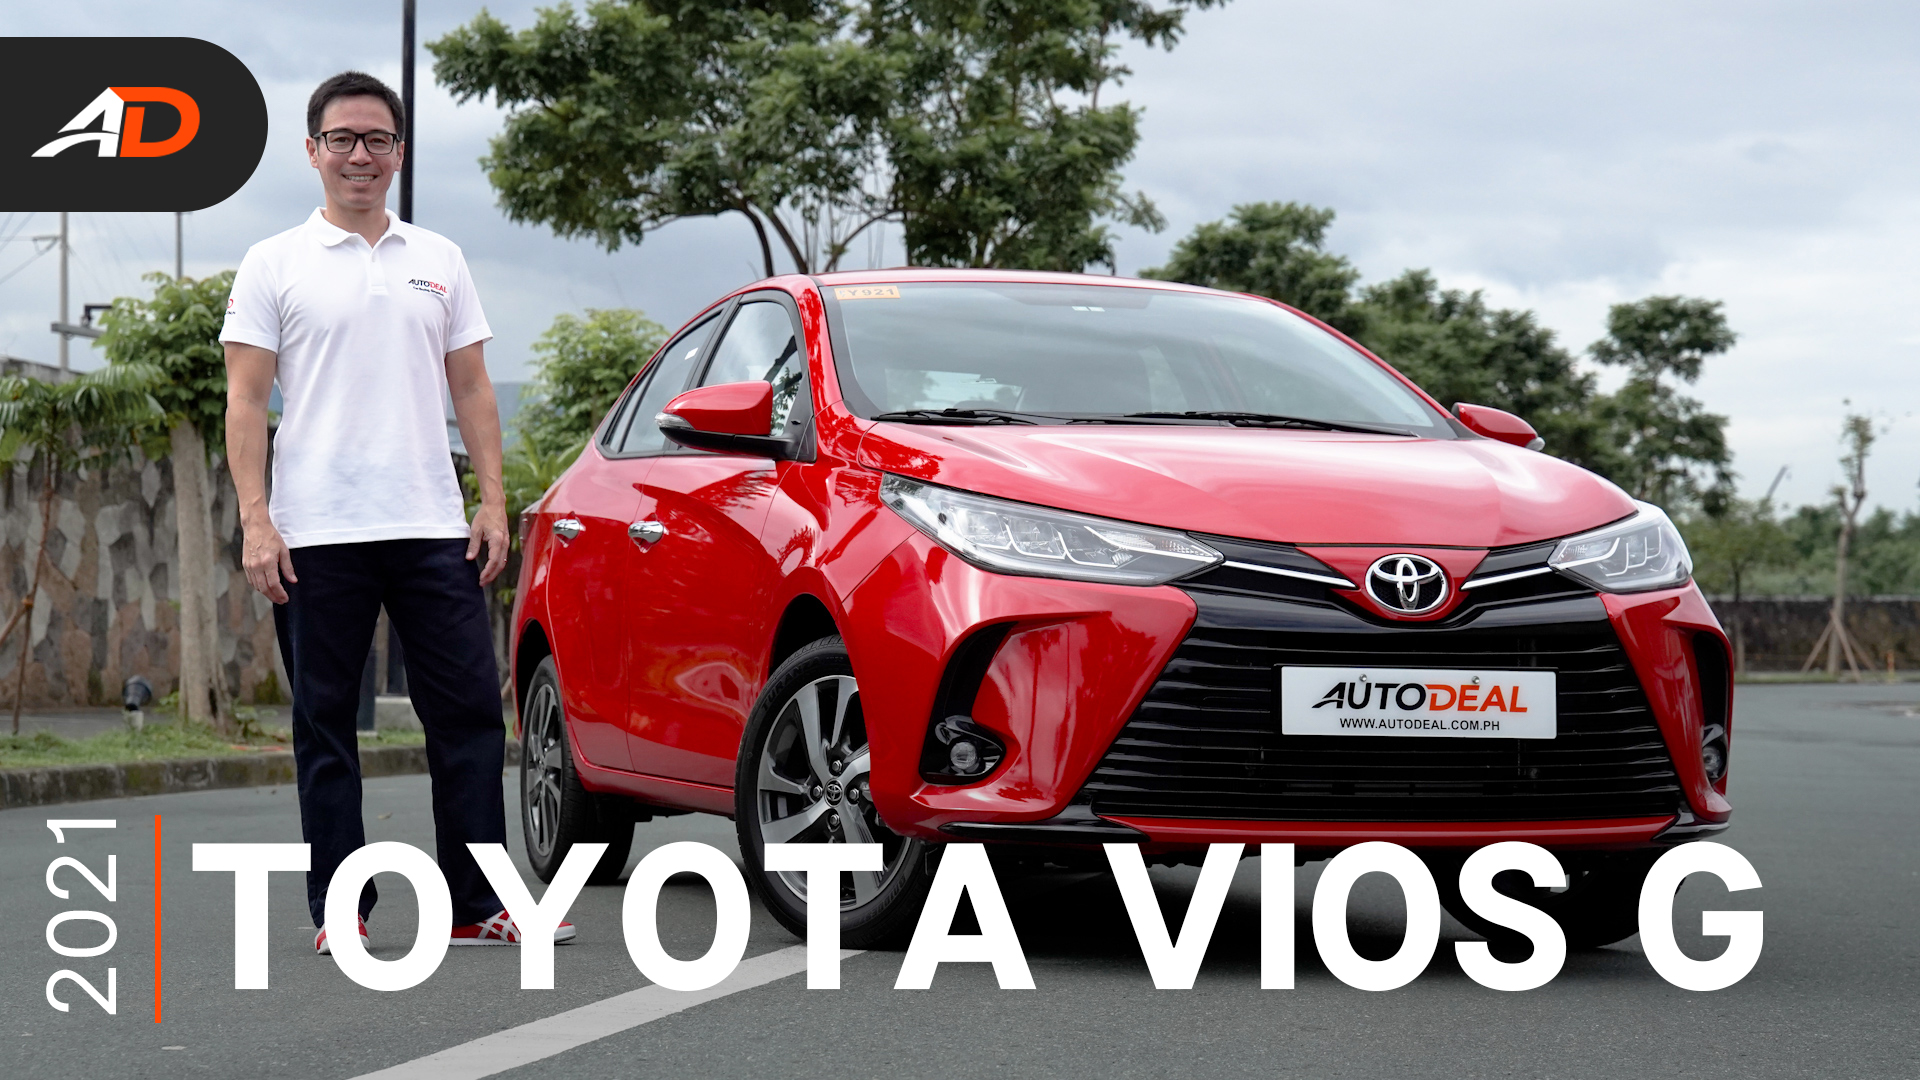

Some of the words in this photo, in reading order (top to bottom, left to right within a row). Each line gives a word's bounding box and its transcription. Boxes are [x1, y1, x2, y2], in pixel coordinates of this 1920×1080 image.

[408, 279, 448, 294] AUTODEAL
[1311, 682, 1528, 713] AUTODEAL
[1339, 718, 1500, 731] WWW.AUTODEAL.COM.PH
